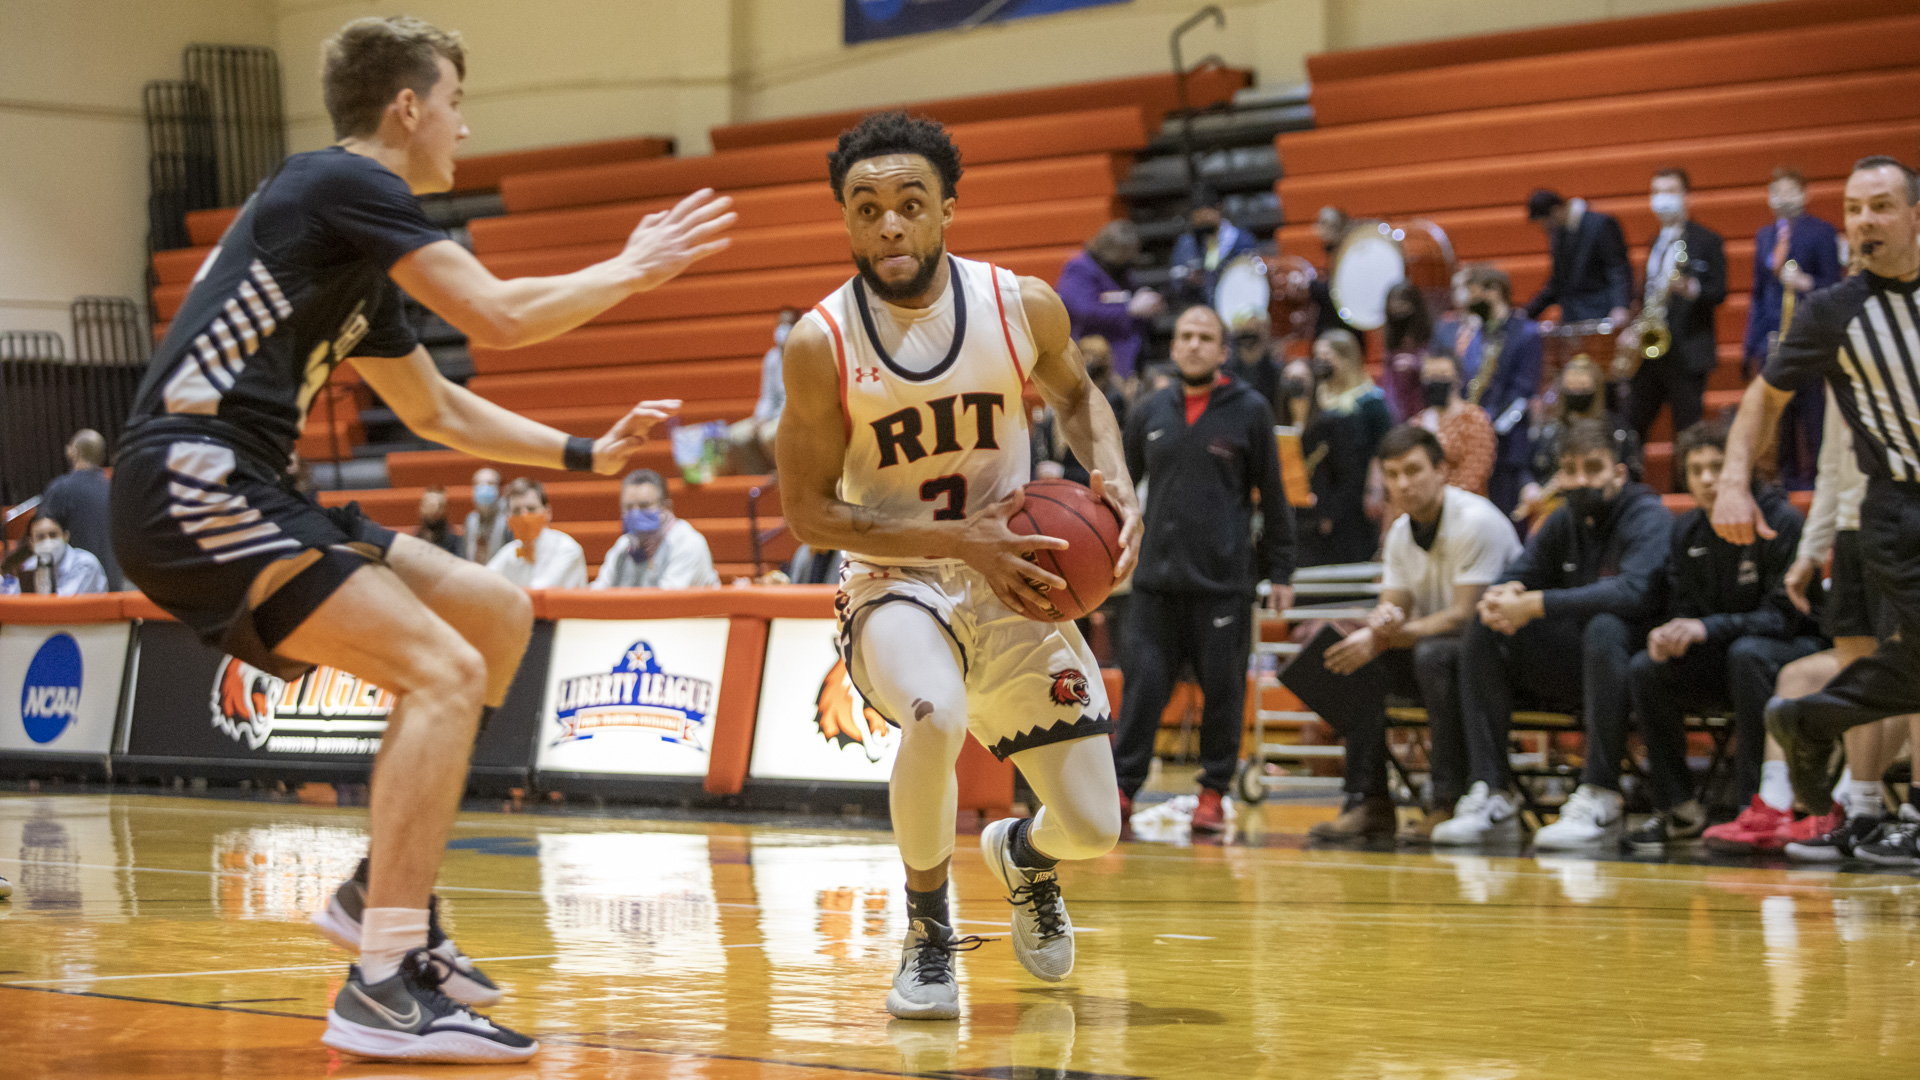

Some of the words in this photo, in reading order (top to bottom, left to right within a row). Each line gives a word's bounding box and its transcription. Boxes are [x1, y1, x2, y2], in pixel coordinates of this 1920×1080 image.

[869, 392, 1005, 470] RIT
[23, 685, 79, 718] NCAA
[558, 672, 638, 712] LIBERTY
[637, 672, 713, 714] LEAGUE
